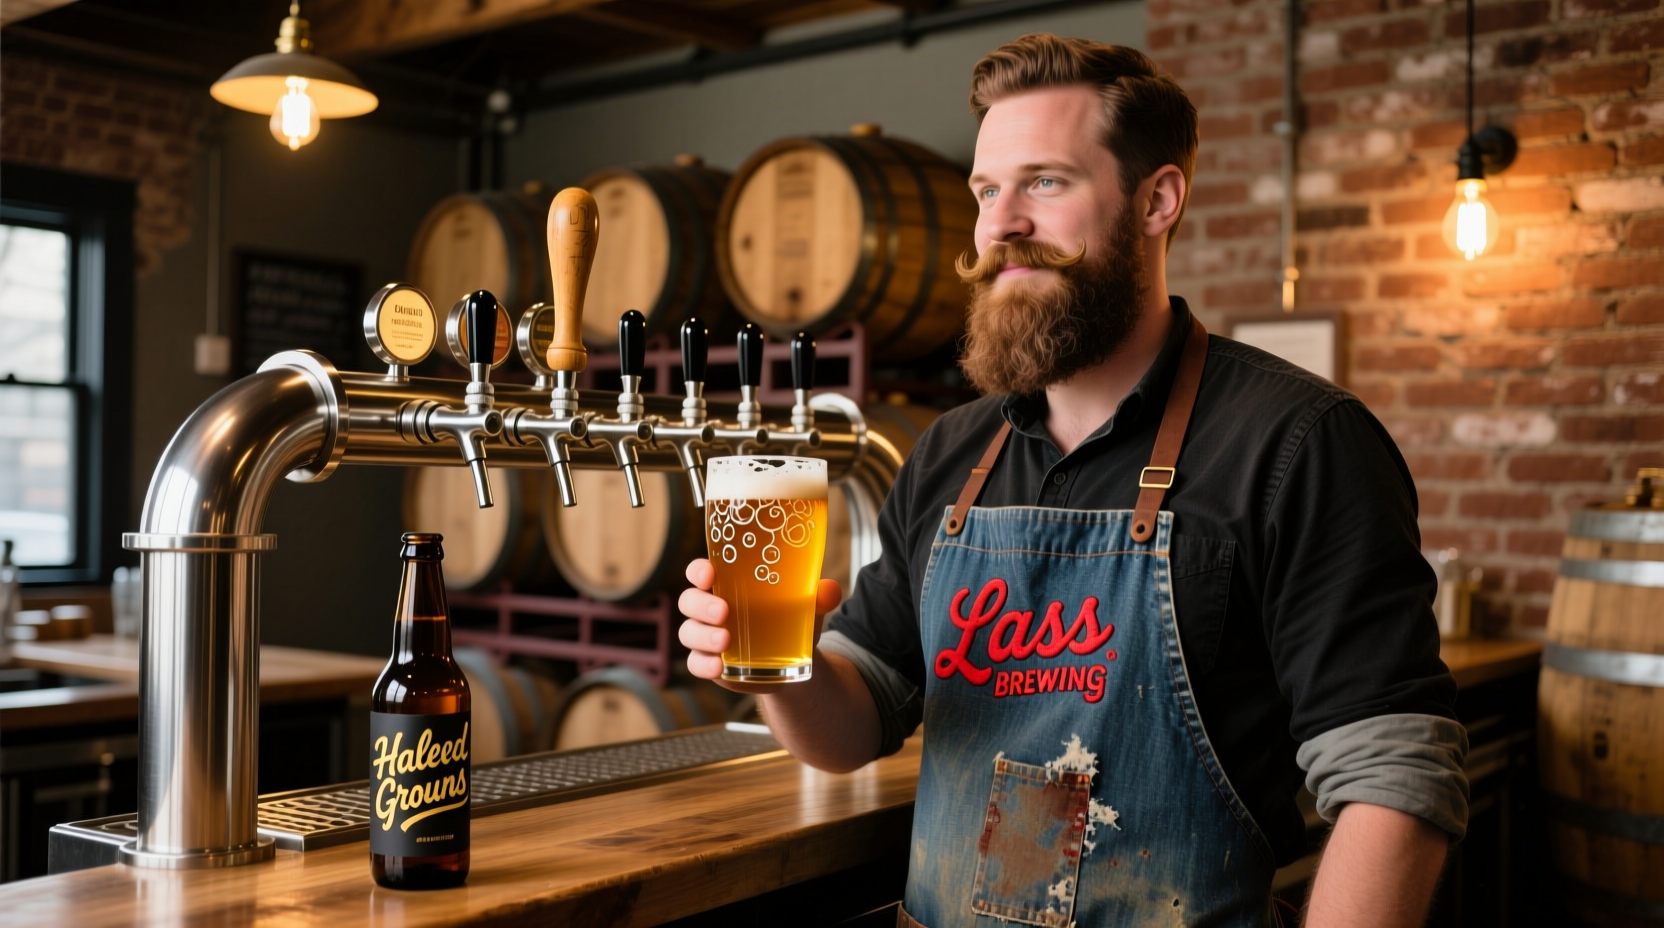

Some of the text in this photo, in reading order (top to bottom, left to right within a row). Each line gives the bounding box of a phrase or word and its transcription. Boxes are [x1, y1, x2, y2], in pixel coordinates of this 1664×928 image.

[934, 577, 1115, 687] Lass
[994, 664, 1107, 704] BREWING
[372, 721, 469, 780] Haleed
[375, 767, 467, 832] Grouns
